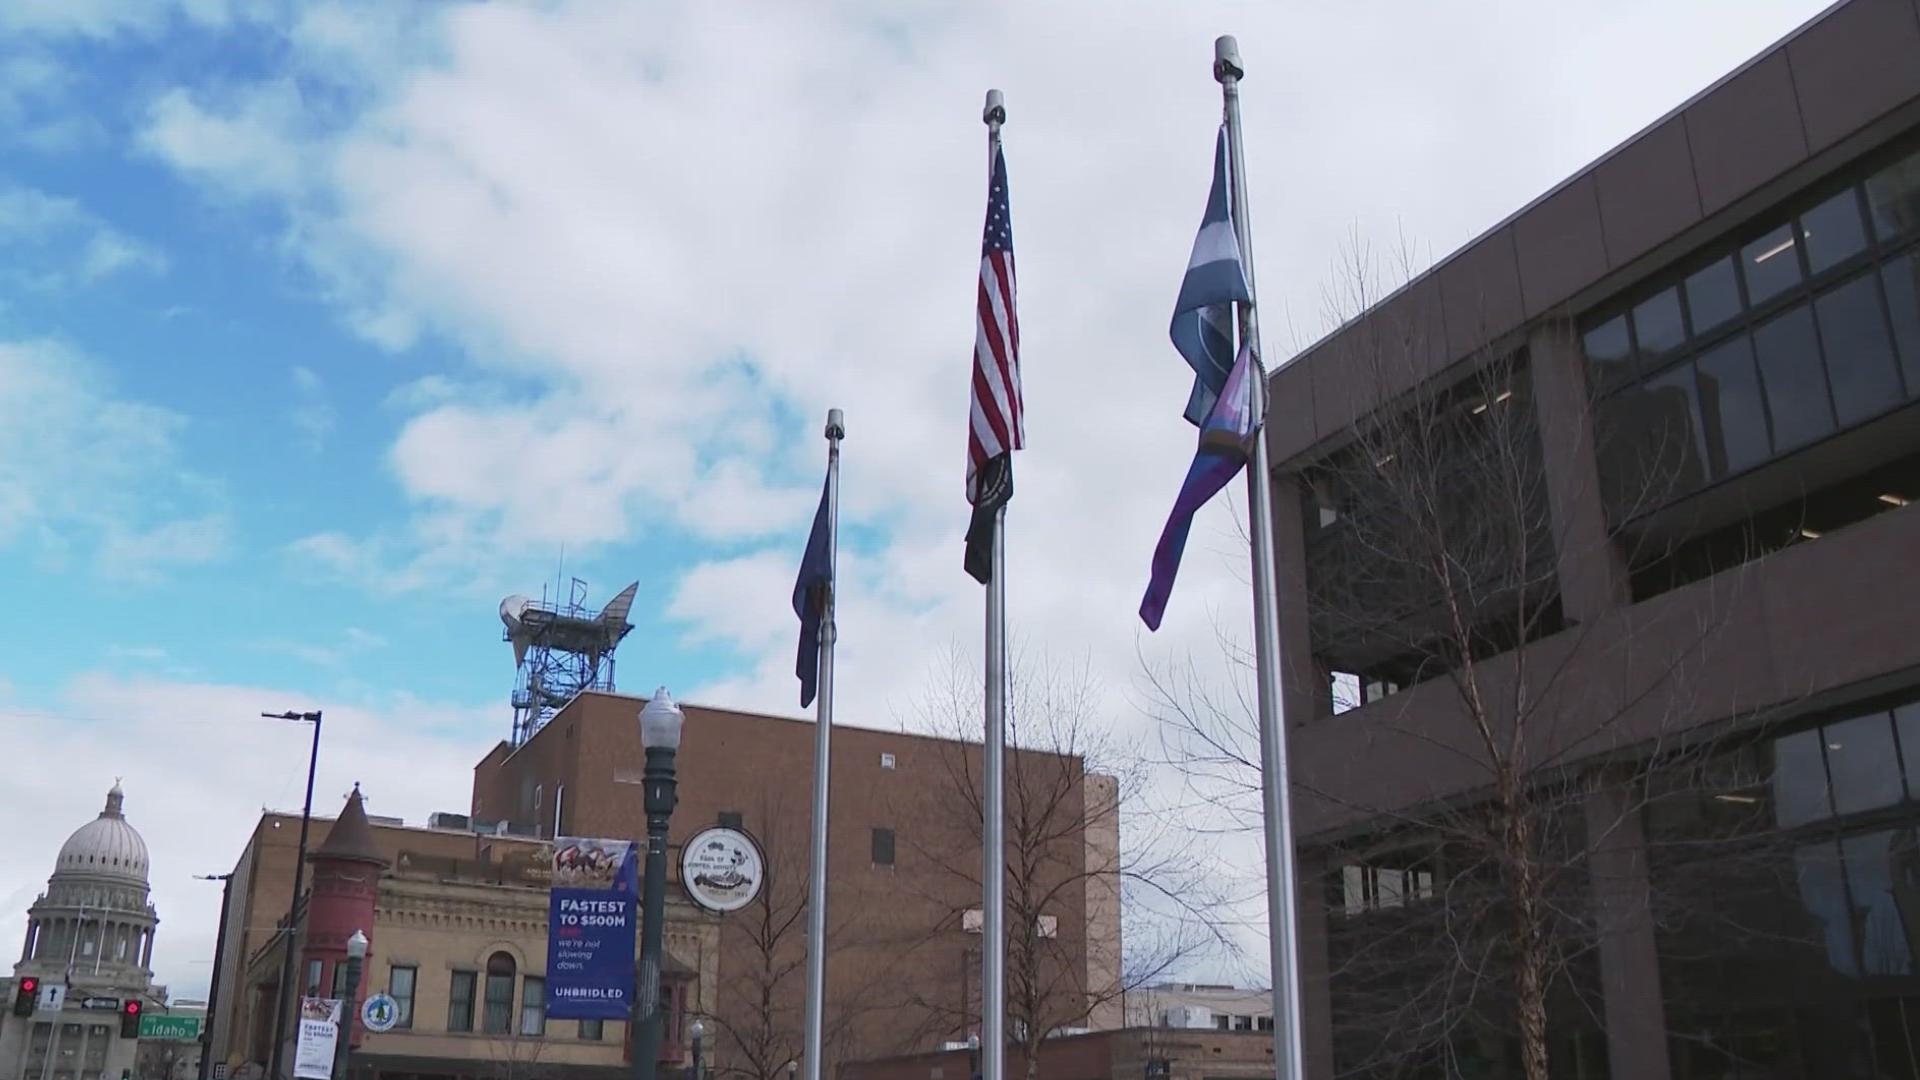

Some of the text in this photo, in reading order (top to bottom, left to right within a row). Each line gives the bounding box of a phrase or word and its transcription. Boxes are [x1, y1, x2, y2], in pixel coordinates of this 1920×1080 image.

[560, 900, 626, 912] FASTEST
[560, 915, 626, 927] TO $500M
[557, 950, 593, 960] slowing
[555, 987, 624, 998] UNBRIDLED
[152, 1024, 186, 1037] Idaho
